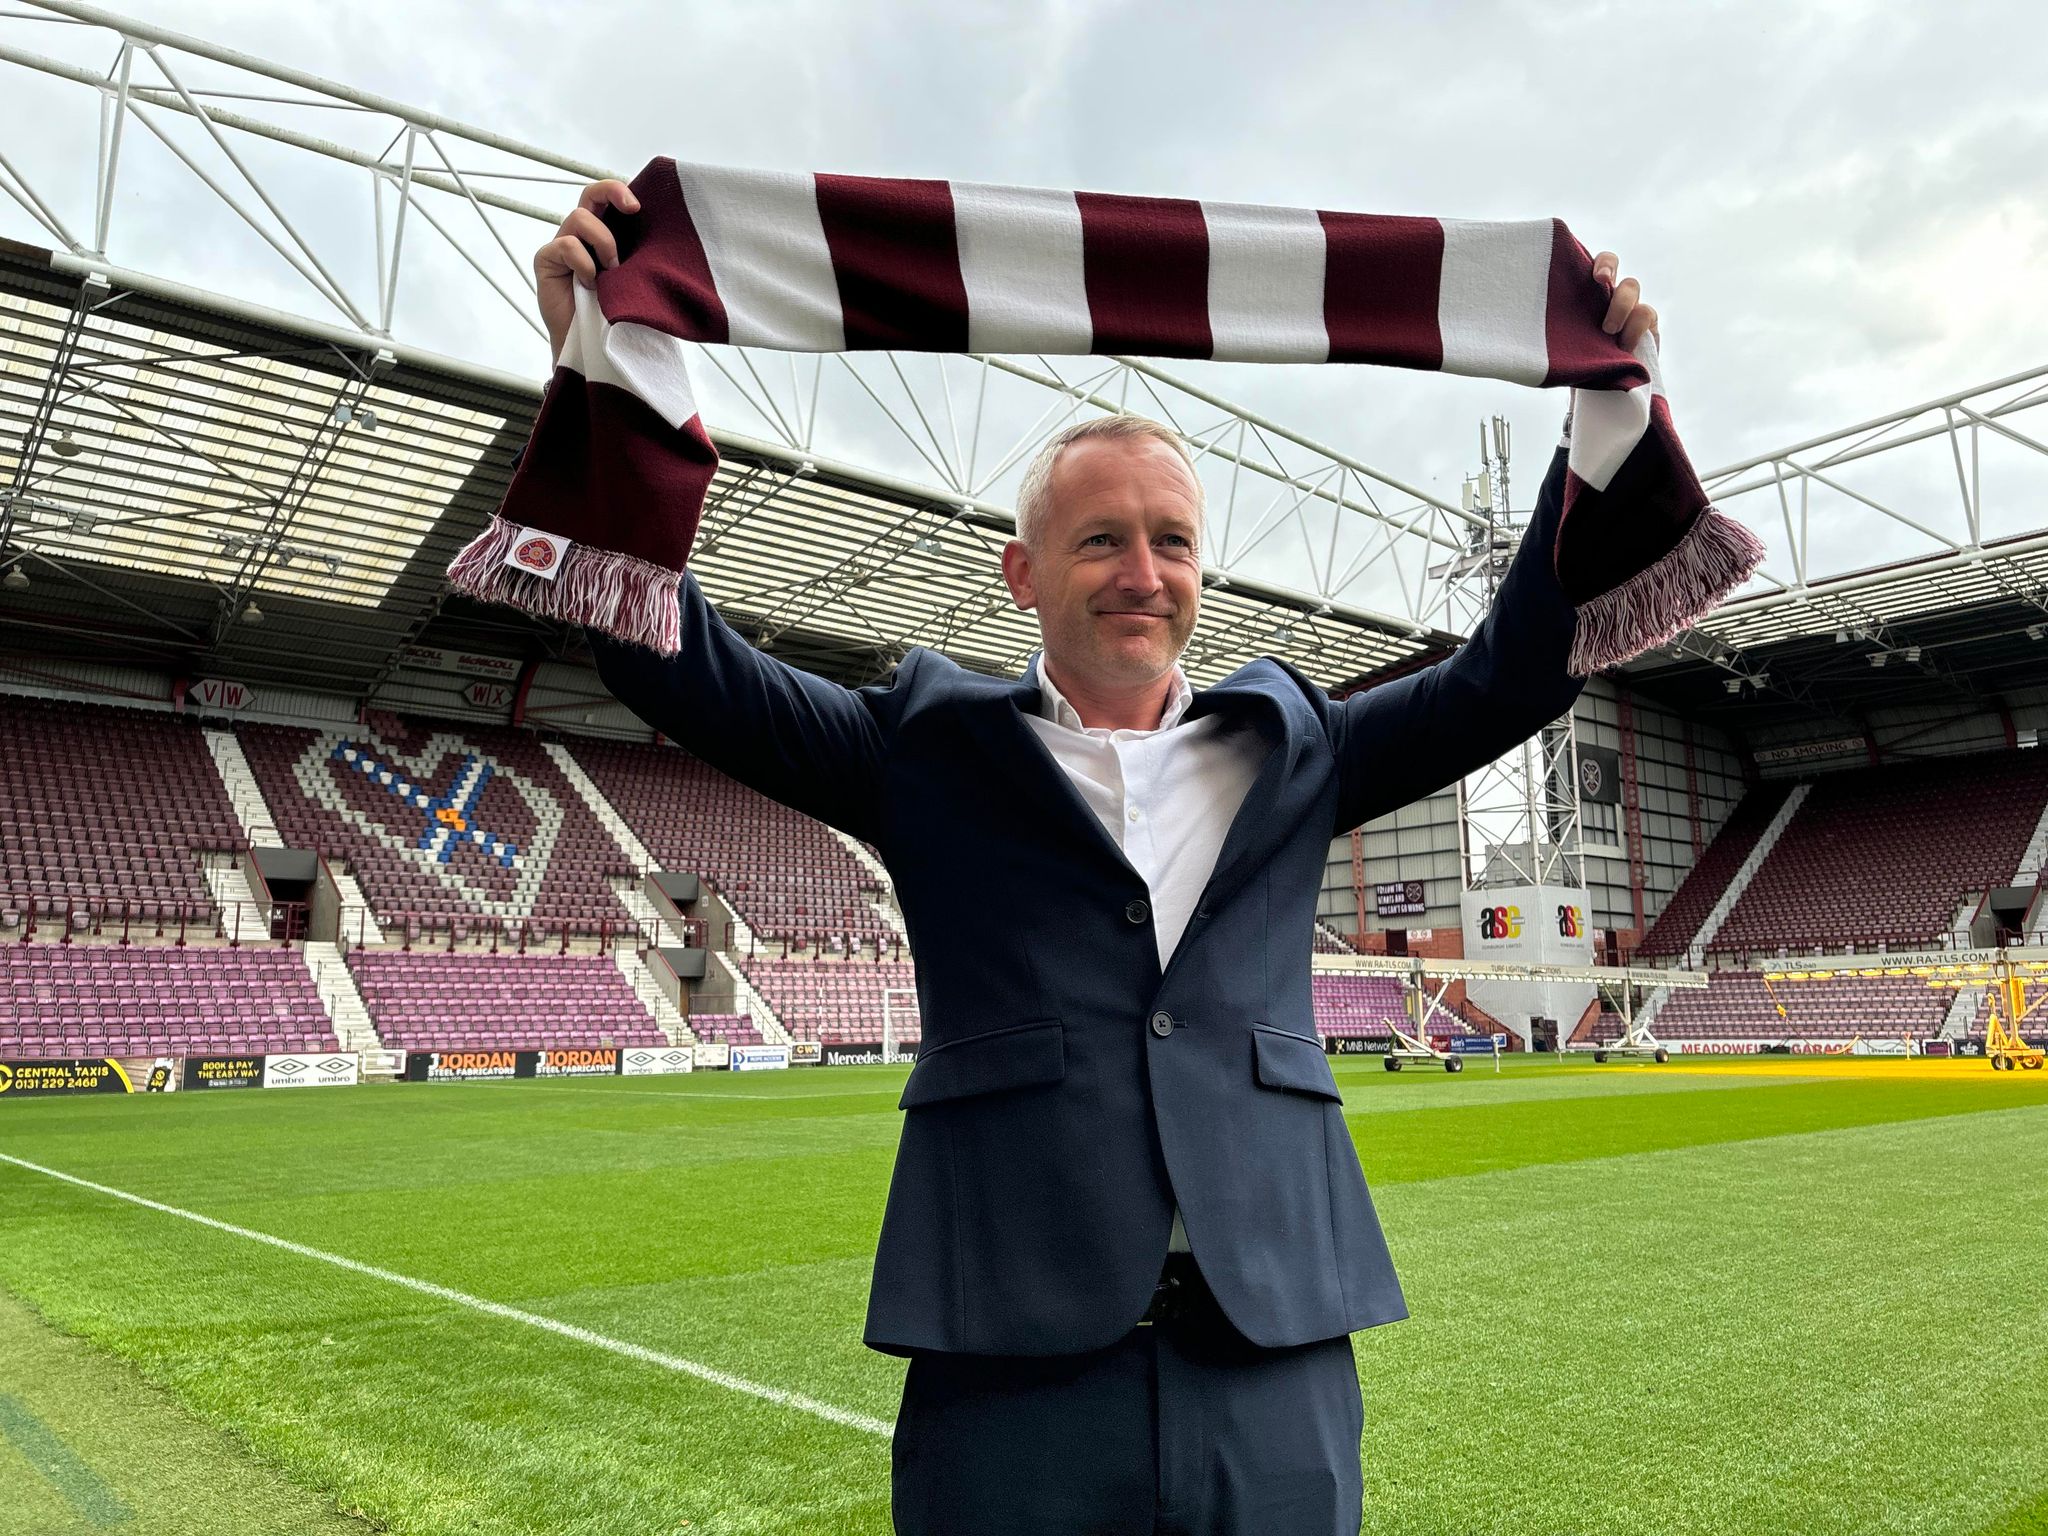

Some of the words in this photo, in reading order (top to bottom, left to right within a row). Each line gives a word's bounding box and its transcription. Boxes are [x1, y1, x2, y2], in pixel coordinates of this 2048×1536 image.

[204, 683, 218, 703] V
[227, 686, 244, 706] W
[473, 686, 488, 702] W
[492, 689, 506, 705] X
[1771, 750, 1790, 760] NO
[1793, 742, 1848, 757] SMOKING
[1355, 959, 1412, 969] WWW.RA-TLS.COM
[1880, 952, 1989, 966] WWW.RA-TLS.COM
[1346, 1040, 1364, 1052] MNB
[439, 1052, 517, 1069] JORDAN
[546, 1049, 617, 1067] JORDAN
[202, 1061, 226, 1071] BOOK
[228, 1061, 235, 1070] &
[236, 1060, 254, 1070] PAY
[428, 1068, 454, 1077] STEEL
[456, 1066, 516, 1076] FABRICATORS
[535, 1065, 560, 1074] STEEL
[561, 1063, 617, 1073] FABRICATORS
[16, 1067, 72, 1078] CENTRAL
[74, 1066, 109, 1077] TAXIS
[197, 1070, 214, 1079] THE
[216, 1069, 239, 1079] EASY
[240, 1069, 260, 1078] WAY
[15, 1079, 39, 1090] 0131
[41, 1078, 65, 1089] 229
[67, 1077, 98, 1088] 2468
[271, 1076, 305, 1085] umbro
[318, 1075, 350, 1083] umbro
